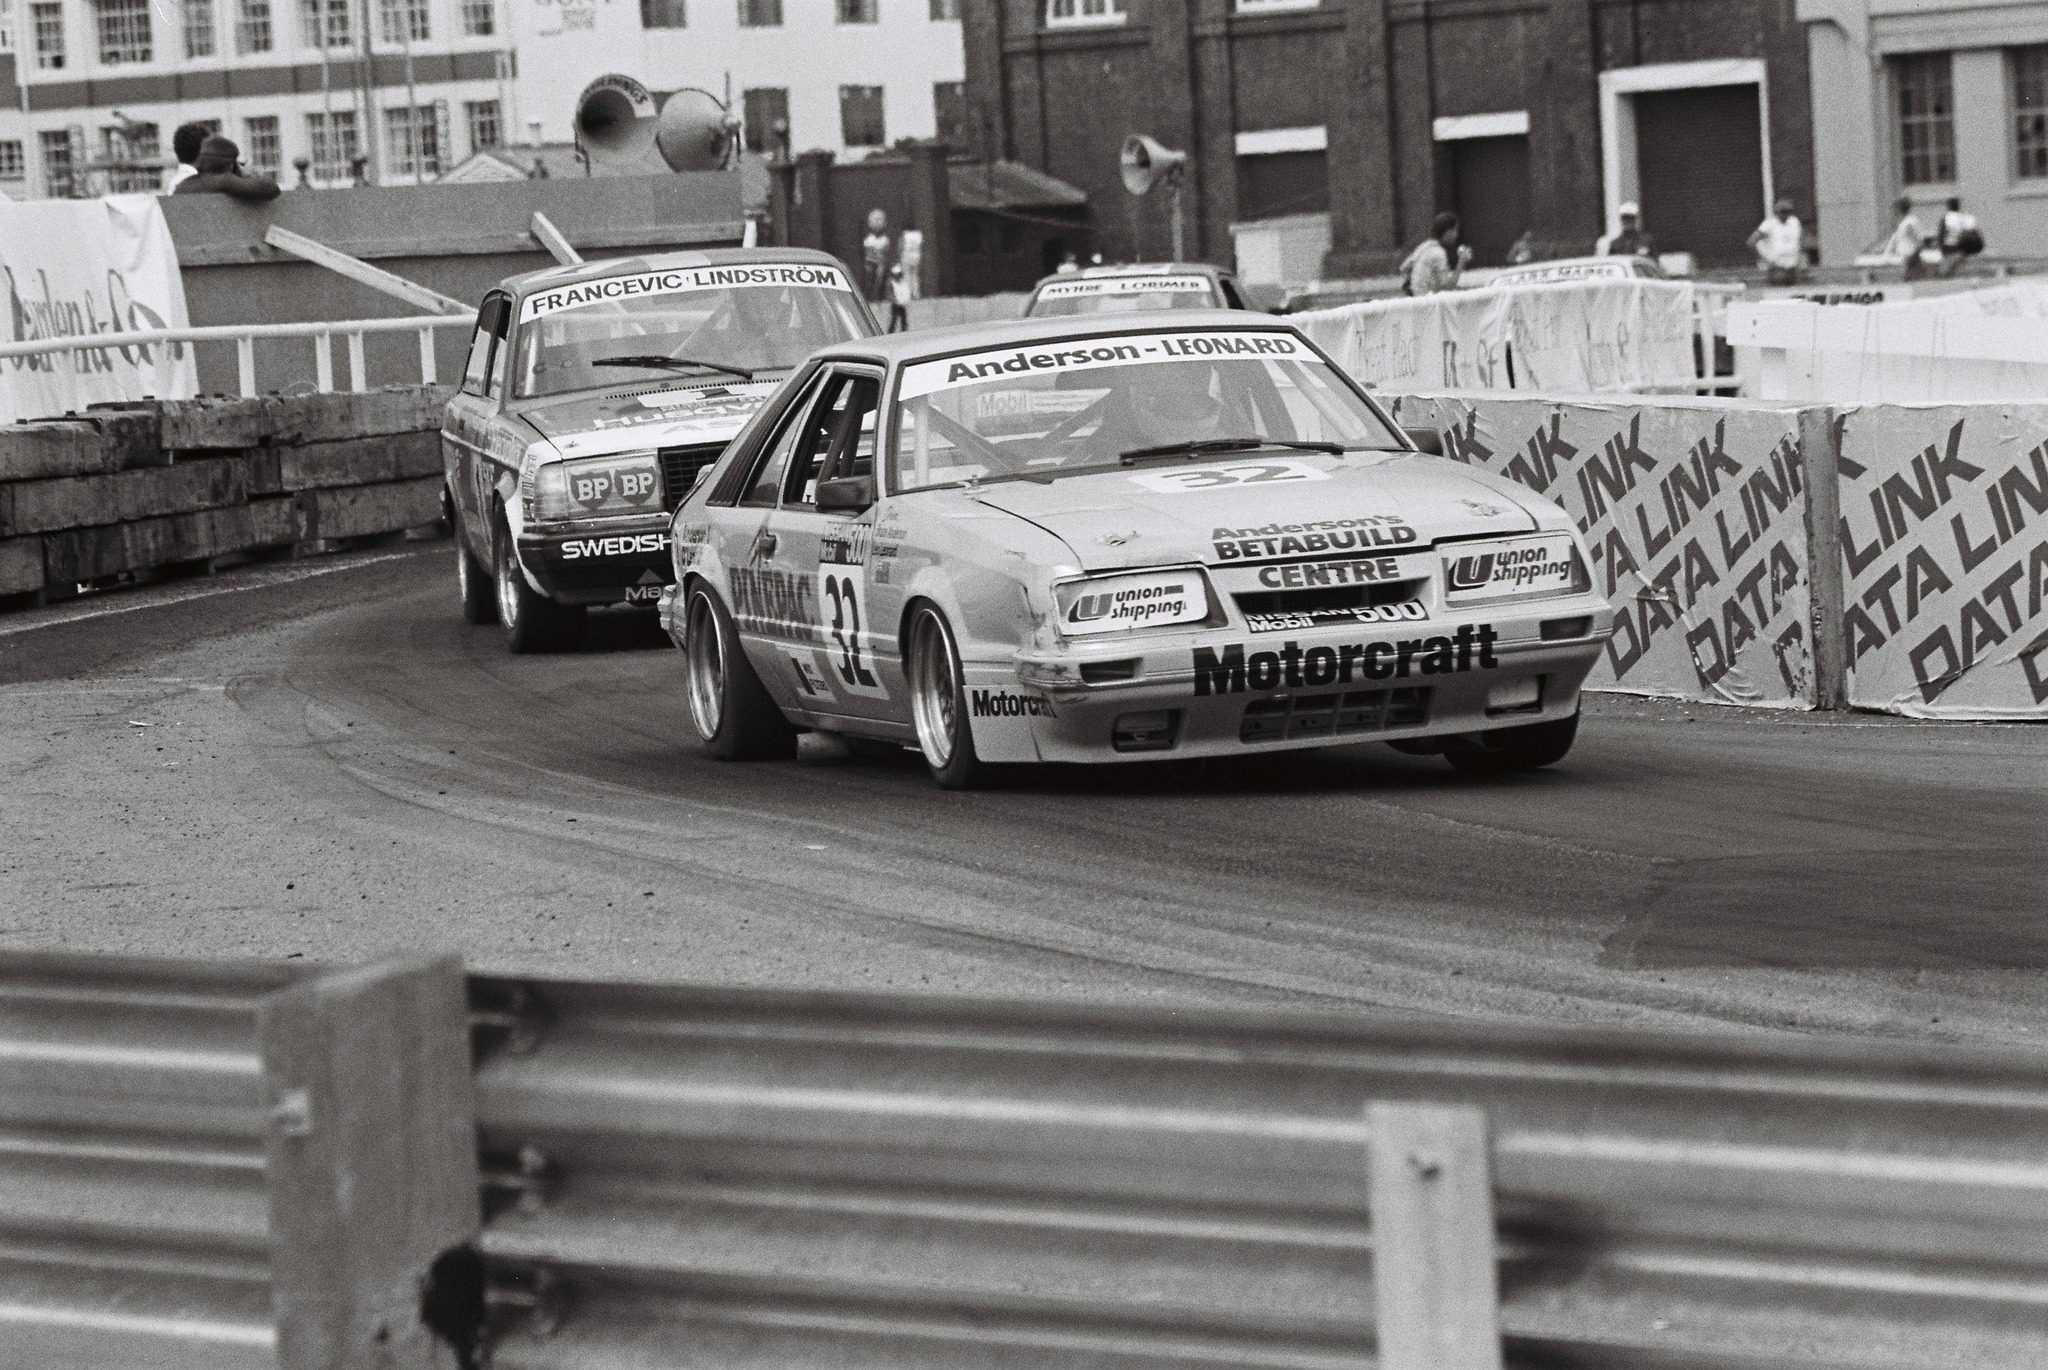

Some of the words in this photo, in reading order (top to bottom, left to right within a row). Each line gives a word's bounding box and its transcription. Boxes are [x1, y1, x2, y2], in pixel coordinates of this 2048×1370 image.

[532, 273, 682, 315] FRANCEVIC
[694, 265, 837, 287] LINDSTRÖM
[947, 344, 1138, 383] Anderson
[1161, 337, 1297, 357] LEONARD
[620, 472, 654, 497] BP
[1161, 464, 1308, 488] 32
[576, 477, 609, 501] BP
[1211, 515, 1404, 540] Anderson's
[561, 533, 673, 560] SWEDISH
[1213, 526, 1417, 560] BETABUILD
[1496, 546, 1547, 567] union
[1844, 544, 1953, 674] ATA
[1950, 438, 2048, 575] LIN
[1258, 558, 1401, 588] CENTRE
[1492, 560, 1571, 586] shipping
[1115, 586, 1163, 602] union
[1111, 600, 1184, 622] shipping
[1350, 601, 1427, 624] 500
[825, 574, 878, 687] 32
[1248, 618, 1315, 633] Mobil
[1192, 622, 1499, 698] Motorcraft
